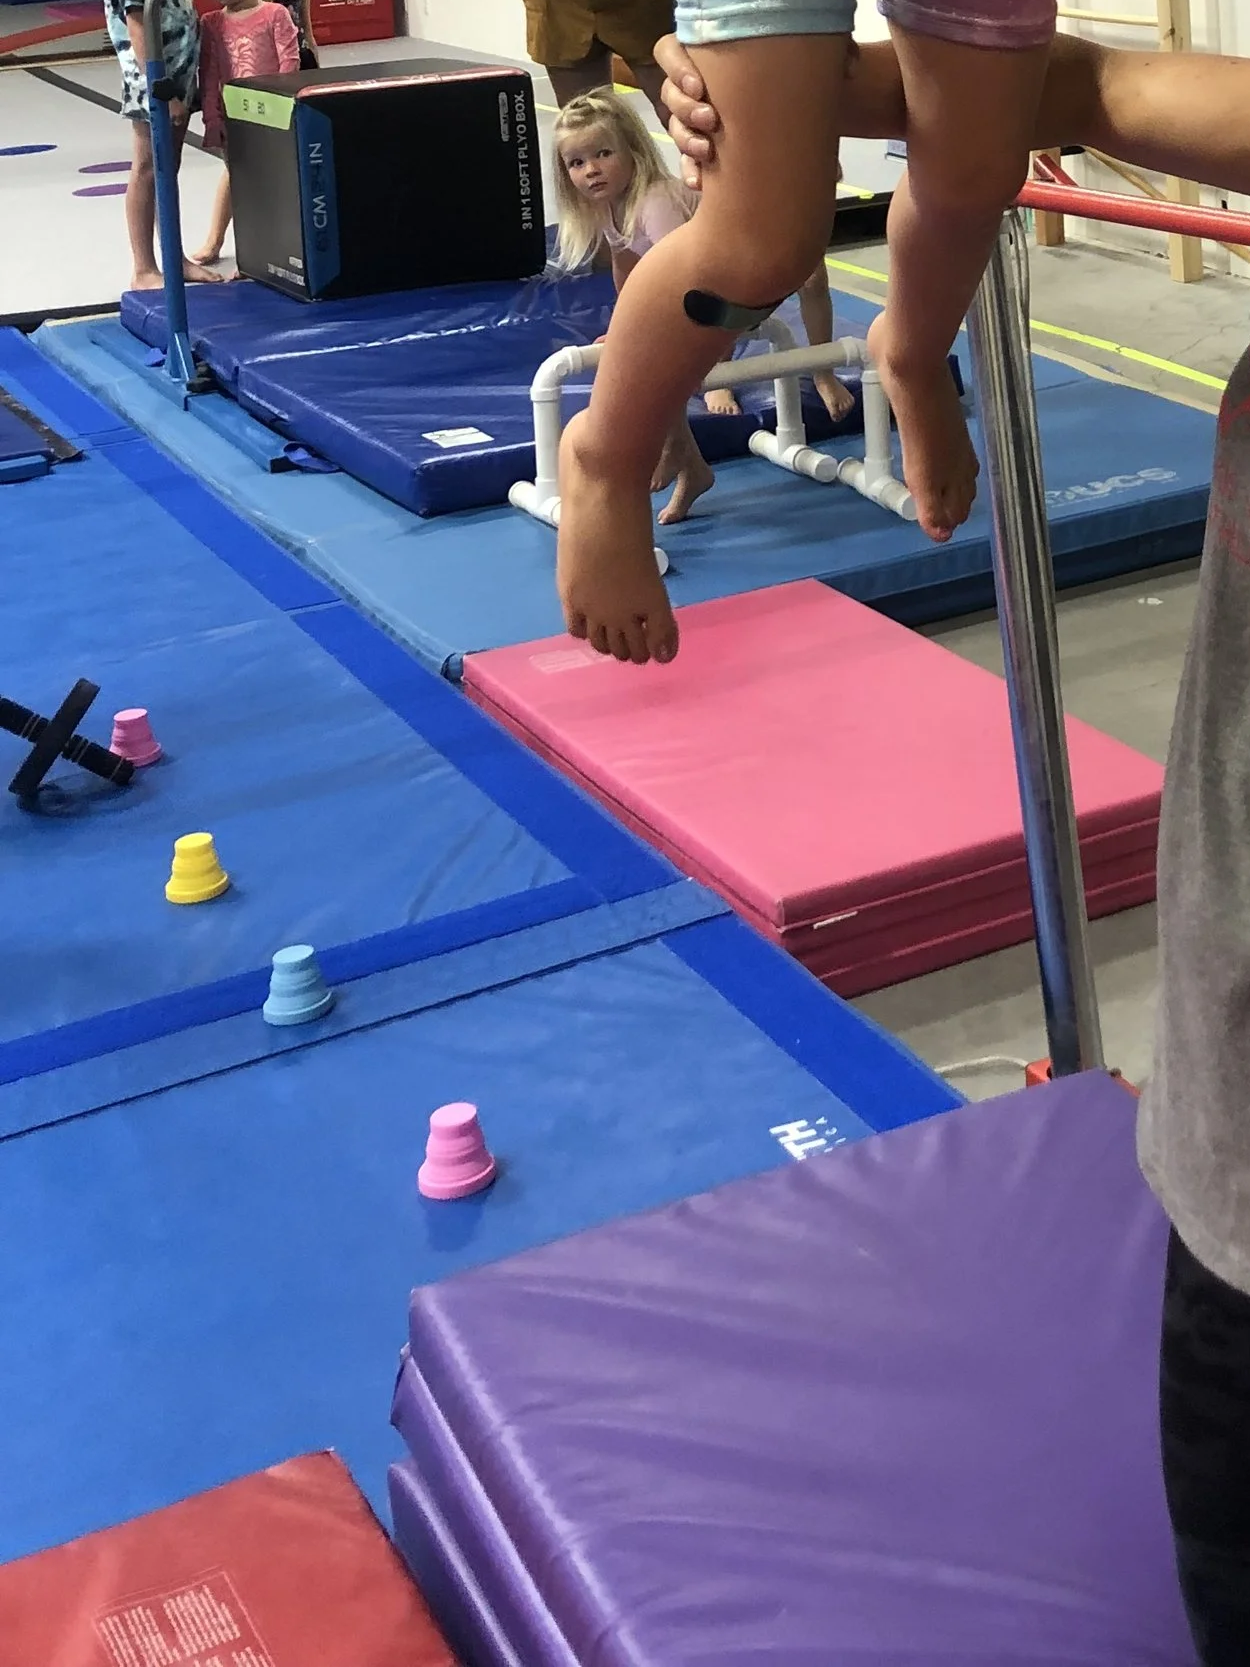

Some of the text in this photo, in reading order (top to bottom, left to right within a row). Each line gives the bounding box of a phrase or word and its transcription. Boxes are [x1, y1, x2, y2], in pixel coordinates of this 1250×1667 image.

[516, 124, 529, 159] PLYO
[518, 162, 531, 196] SOFT
[521, 206, 532, 220] IN
